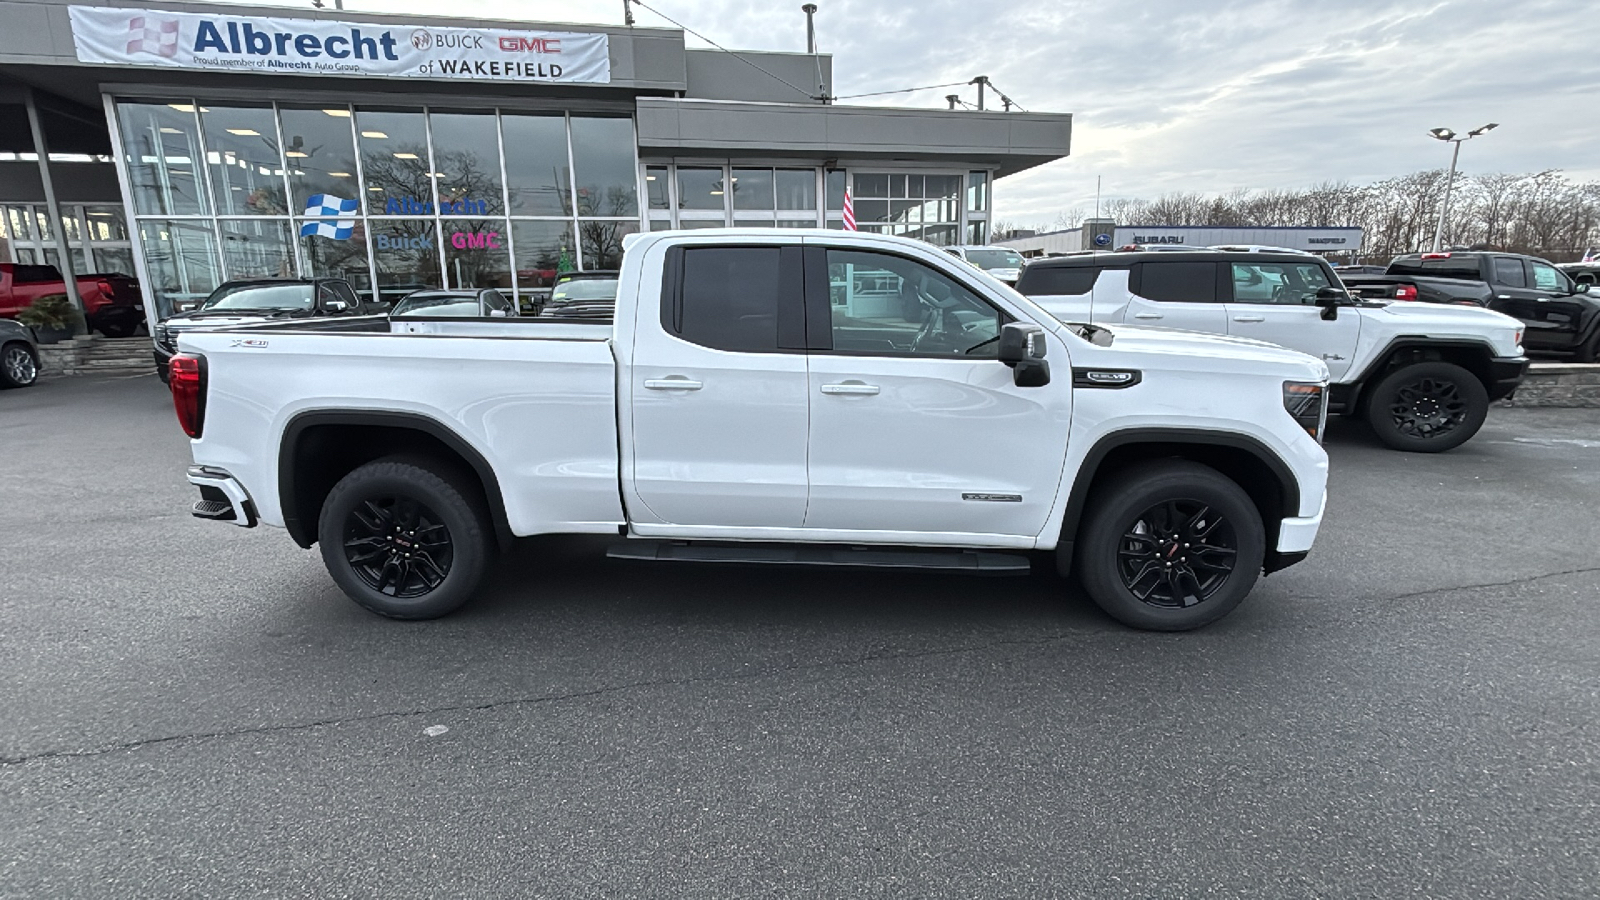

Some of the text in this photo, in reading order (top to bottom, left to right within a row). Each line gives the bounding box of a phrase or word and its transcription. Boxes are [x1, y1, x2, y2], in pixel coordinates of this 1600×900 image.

[194, 20, 399, 60] Albrecht
[436, 34, 562, 54] BUICK GMC
[193, 56, 360, 72] Proud member of Albrecht Auto Group
[419, 59, 563, 78] of WAKEFIELD
[386, 196, 487, 214] Albrecht
[376, 232, 501, 250] Buick GMC
[1133, 235, 1184, 244] SUBARU
